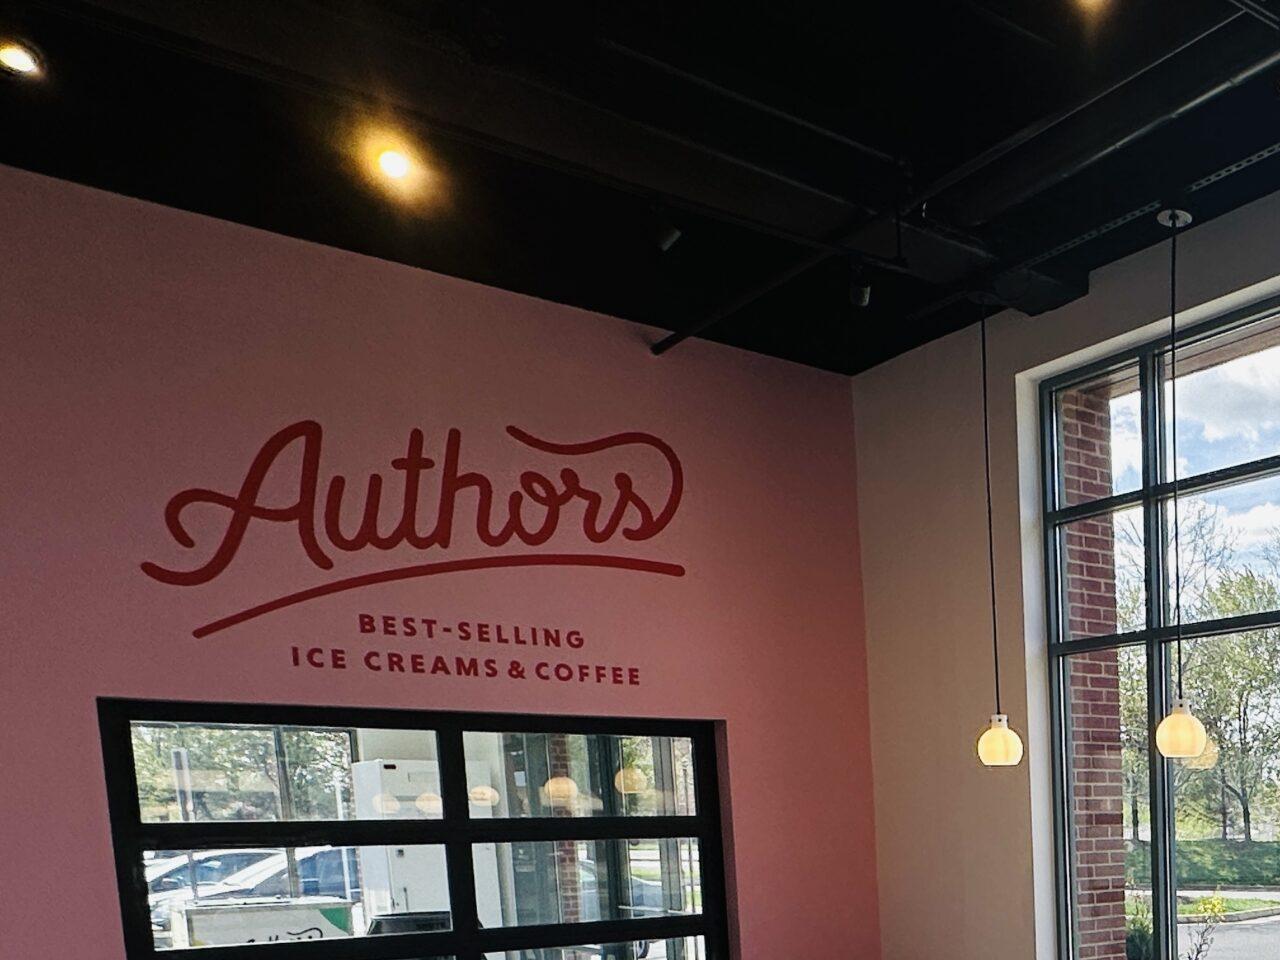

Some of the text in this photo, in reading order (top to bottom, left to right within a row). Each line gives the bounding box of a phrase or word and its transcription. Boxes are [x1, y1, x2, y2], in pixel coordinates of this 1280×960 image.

[140, 420, 684, 586] Authors
[358, 613, 585, 649] BEST-SELLING
[291, 646, 640, 686] ICE CREAMS & COFFEE
